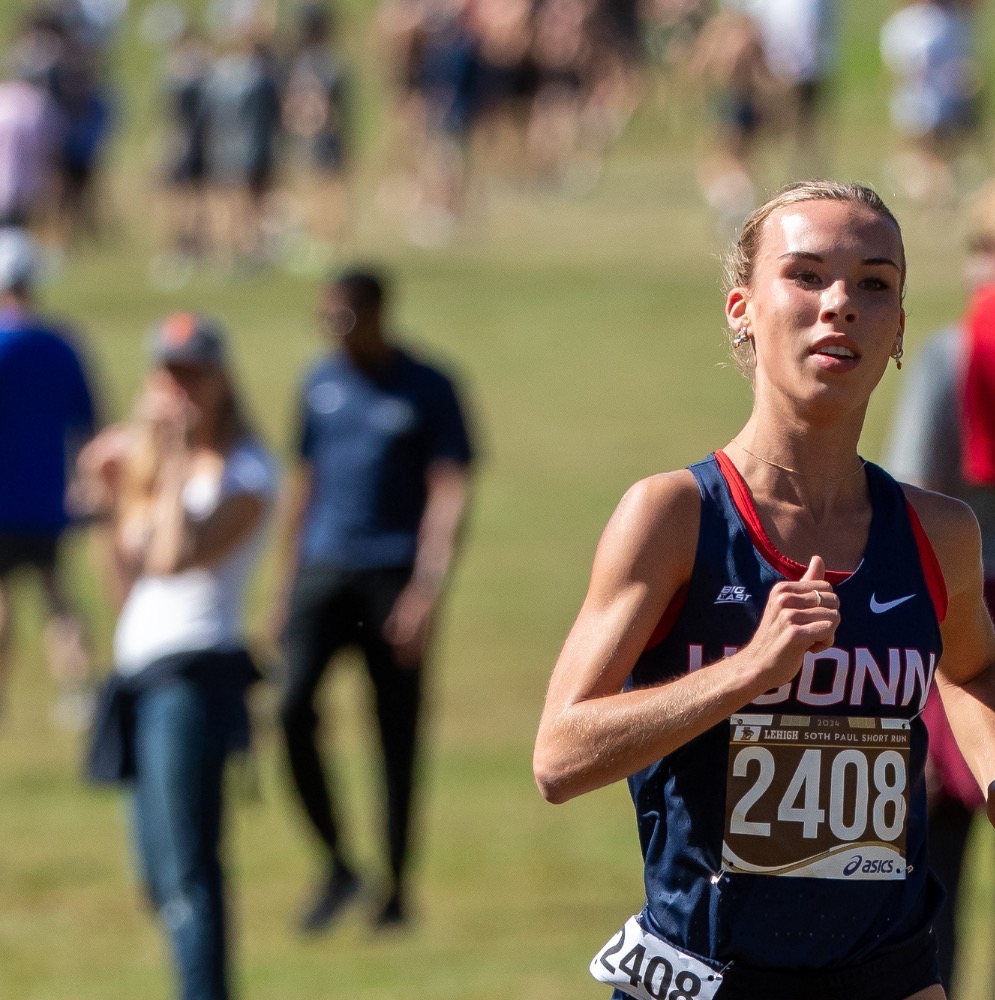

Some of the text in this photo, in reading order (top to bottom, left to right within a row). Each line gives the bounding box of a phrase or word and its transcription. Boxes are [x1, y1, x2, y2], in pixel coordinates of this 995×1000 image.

[721, 585, 746, 594] BIG
[716, 594, 752, 602] EAST
[689, 644, 936, 710] ONN
[817, 719, 840, 727] 2024
[764, 729, 907, 743] LEHIGH 50TH PAUL SHORT RUN
[730, 746, 907, 841] 2408
